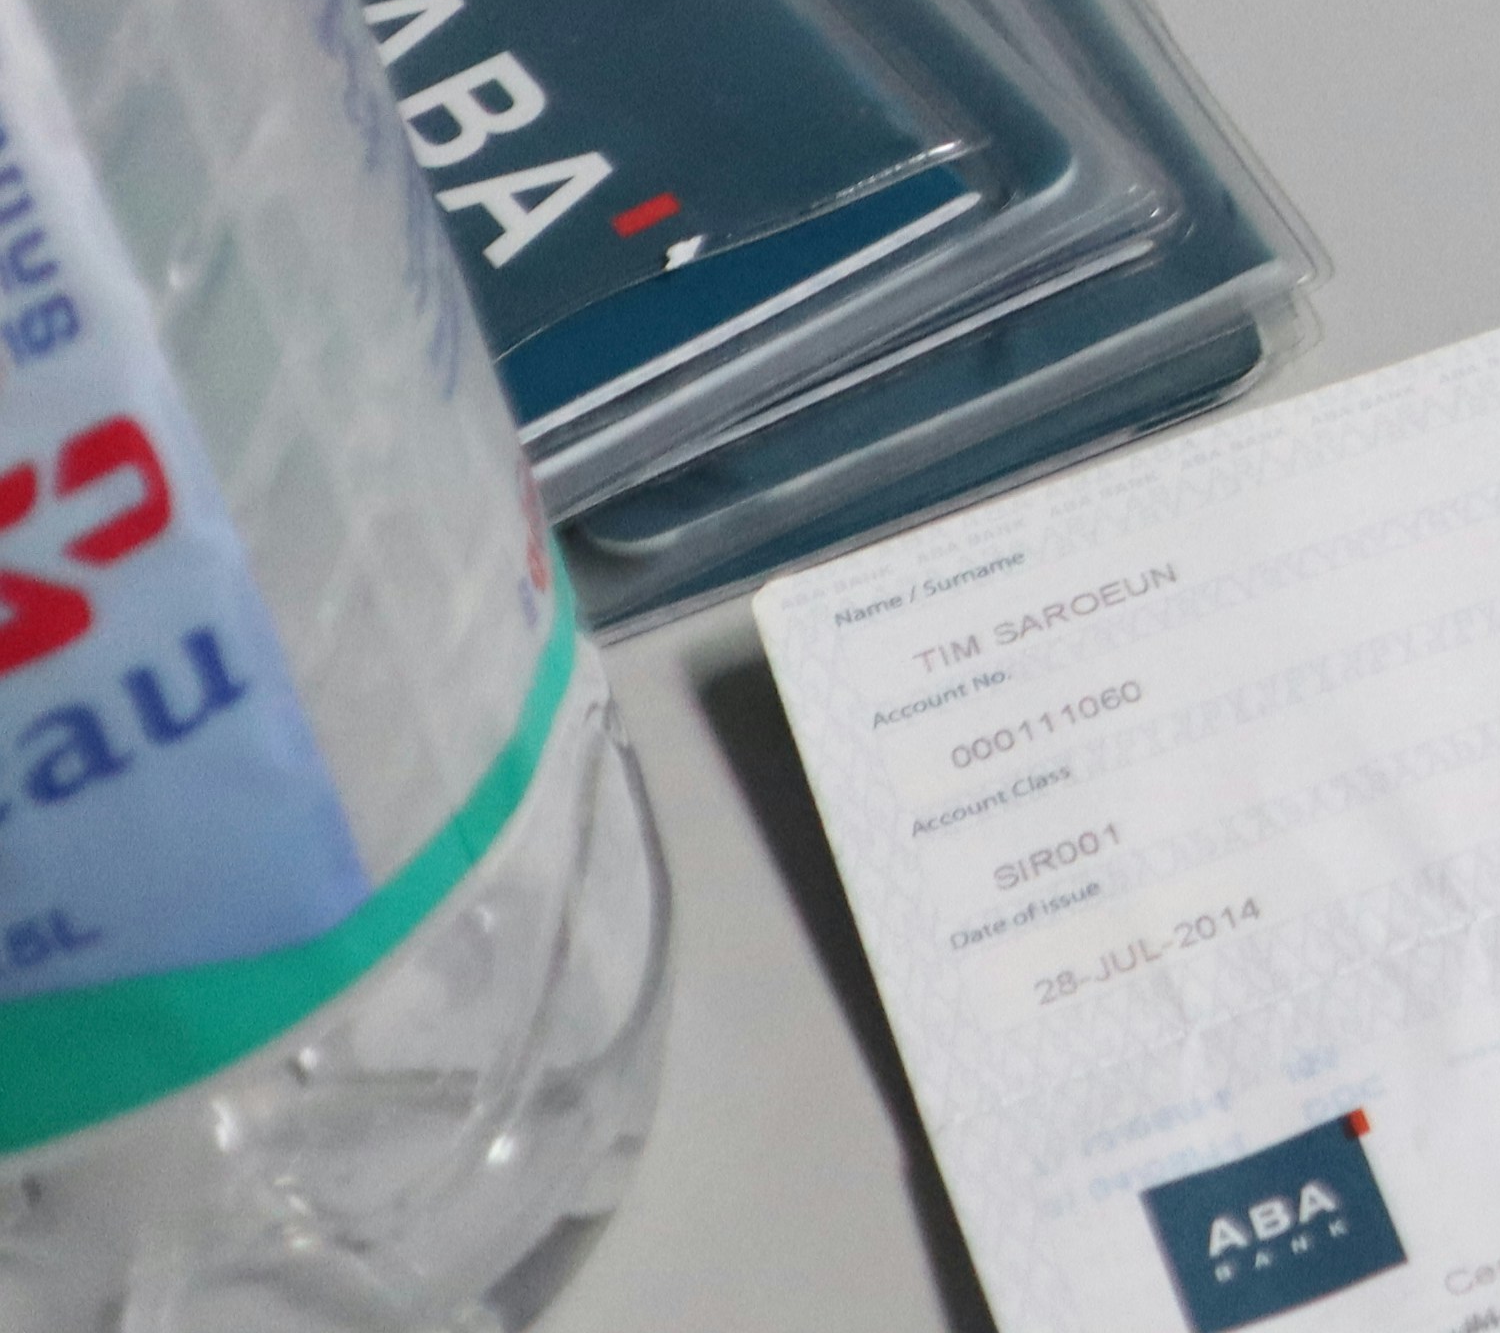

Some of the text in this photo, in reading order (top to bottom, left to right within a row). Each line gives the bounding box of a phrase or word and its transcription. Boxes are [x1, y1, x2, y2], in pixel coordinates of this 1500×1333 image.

[833, 597, 900, 630] Name
[922, 549, 1027, 603] Surname
[912, 560, 1181, 677] TIM SAROEUN
[871, 666, 1014, 731] Account No.
[950, 679, 1144, 772] 000111060
[909, 761, 1073, 838] Account Class
[992, 820, 1123, 893] SIR001
[949, 917, 1000, 951] Date
[1038, 878, 1103, 920] issue
[1032, 895, 1265, 1008] 28-JUL-2014
[1205, 1179, 1343, 1258] ABA
[1213, 1217, 1349, 1283] BANK
